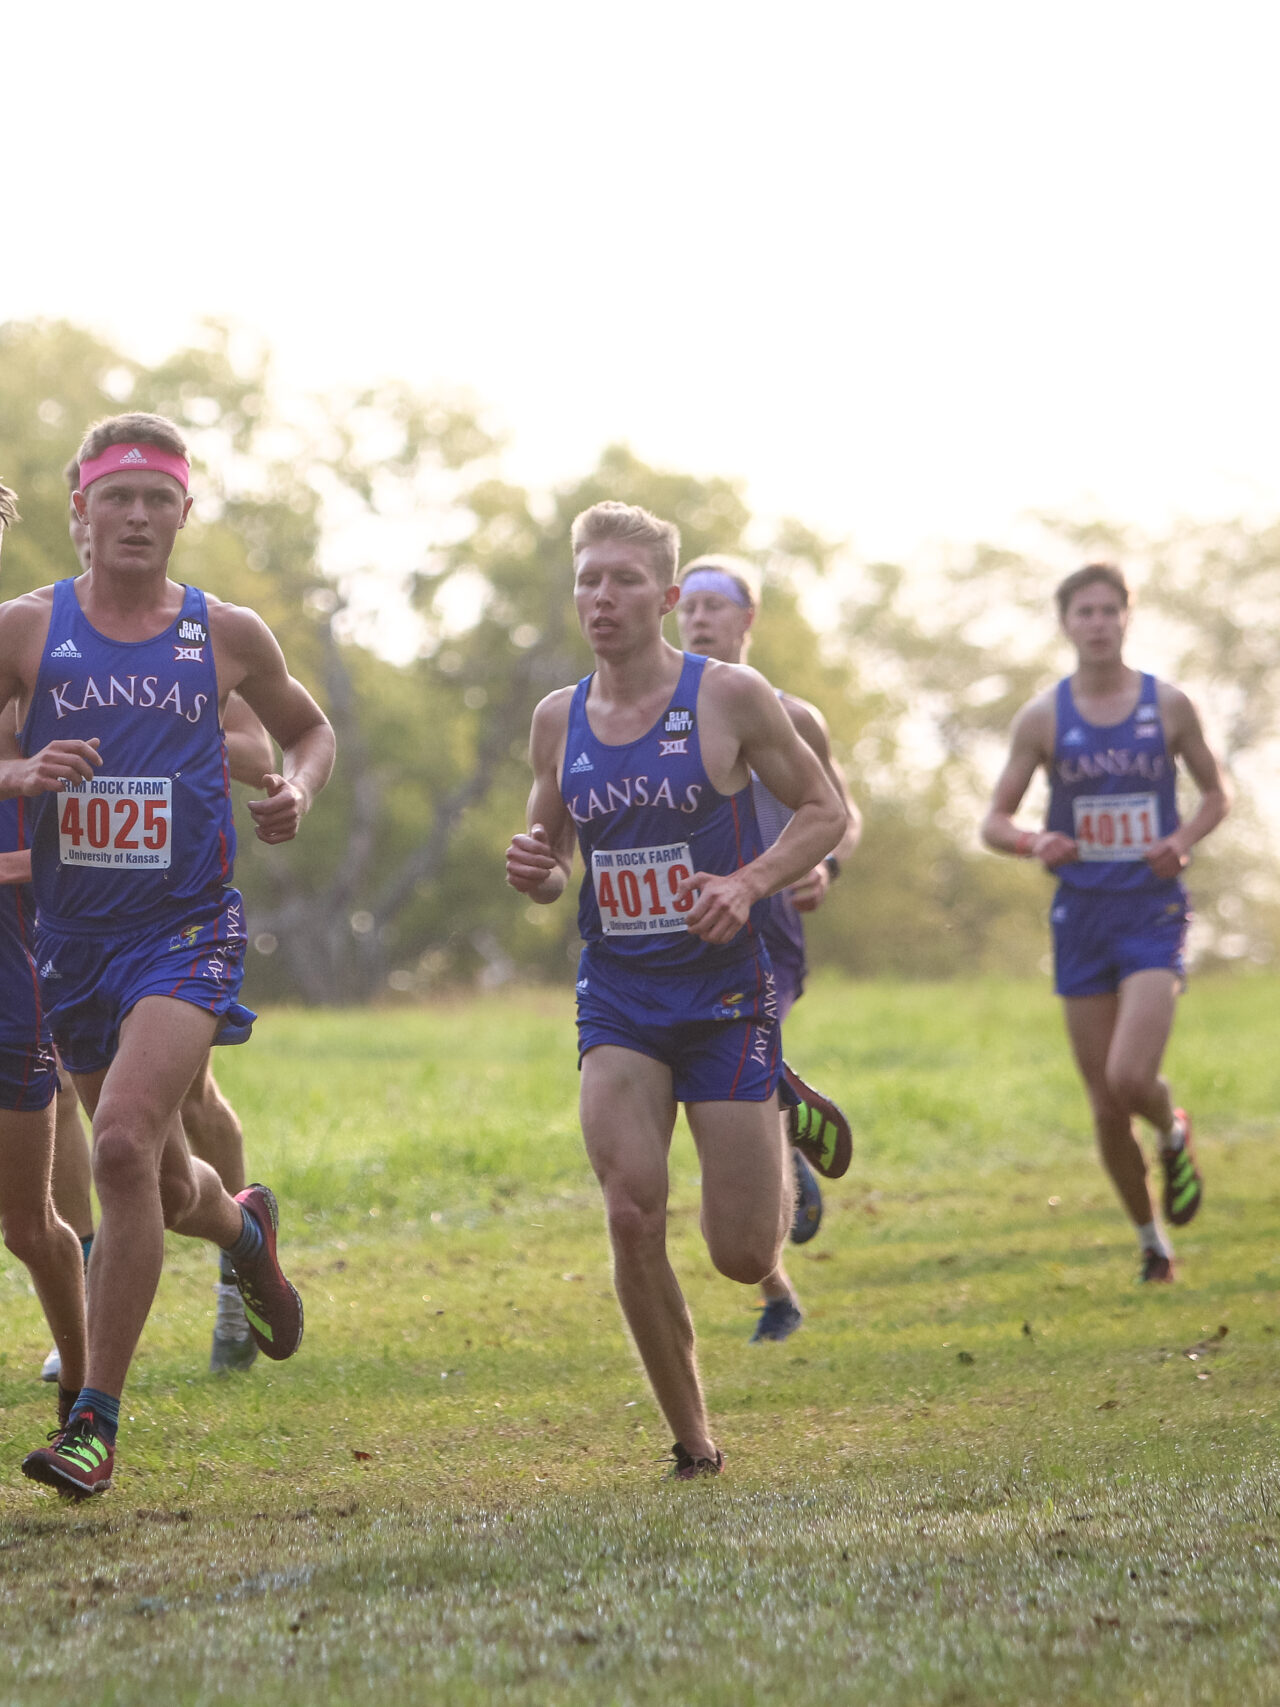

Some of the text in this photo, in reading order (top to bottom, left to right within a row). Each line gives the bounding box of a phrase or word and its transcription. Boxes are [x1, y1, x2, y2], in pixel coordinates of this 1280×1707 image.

[182, 620, 202, 632] BLM
[178, 628, 206, 642] UNITY
[51, 650, 82, 658] adidas
[49, 675, 208, 723] KANSAS
[668, 711, 690, 721] BLM
[664, 720, 694, 731] UNITY
[90, 780, 124, 795] ROCK
[128, 781, 164, 795] FARM
[566, 775, 702, 828] KANSAS
[60, 797, 167, 850] 4025
[1078, 812, 1152, 846] 4011
[68, 849, 160, 864] University of Kansas
[594, 847, 683, 867] RIM ROCK FARM
[599, 863, 694, 918] 4019
[609, 917, 686, 931] University of Kansa
